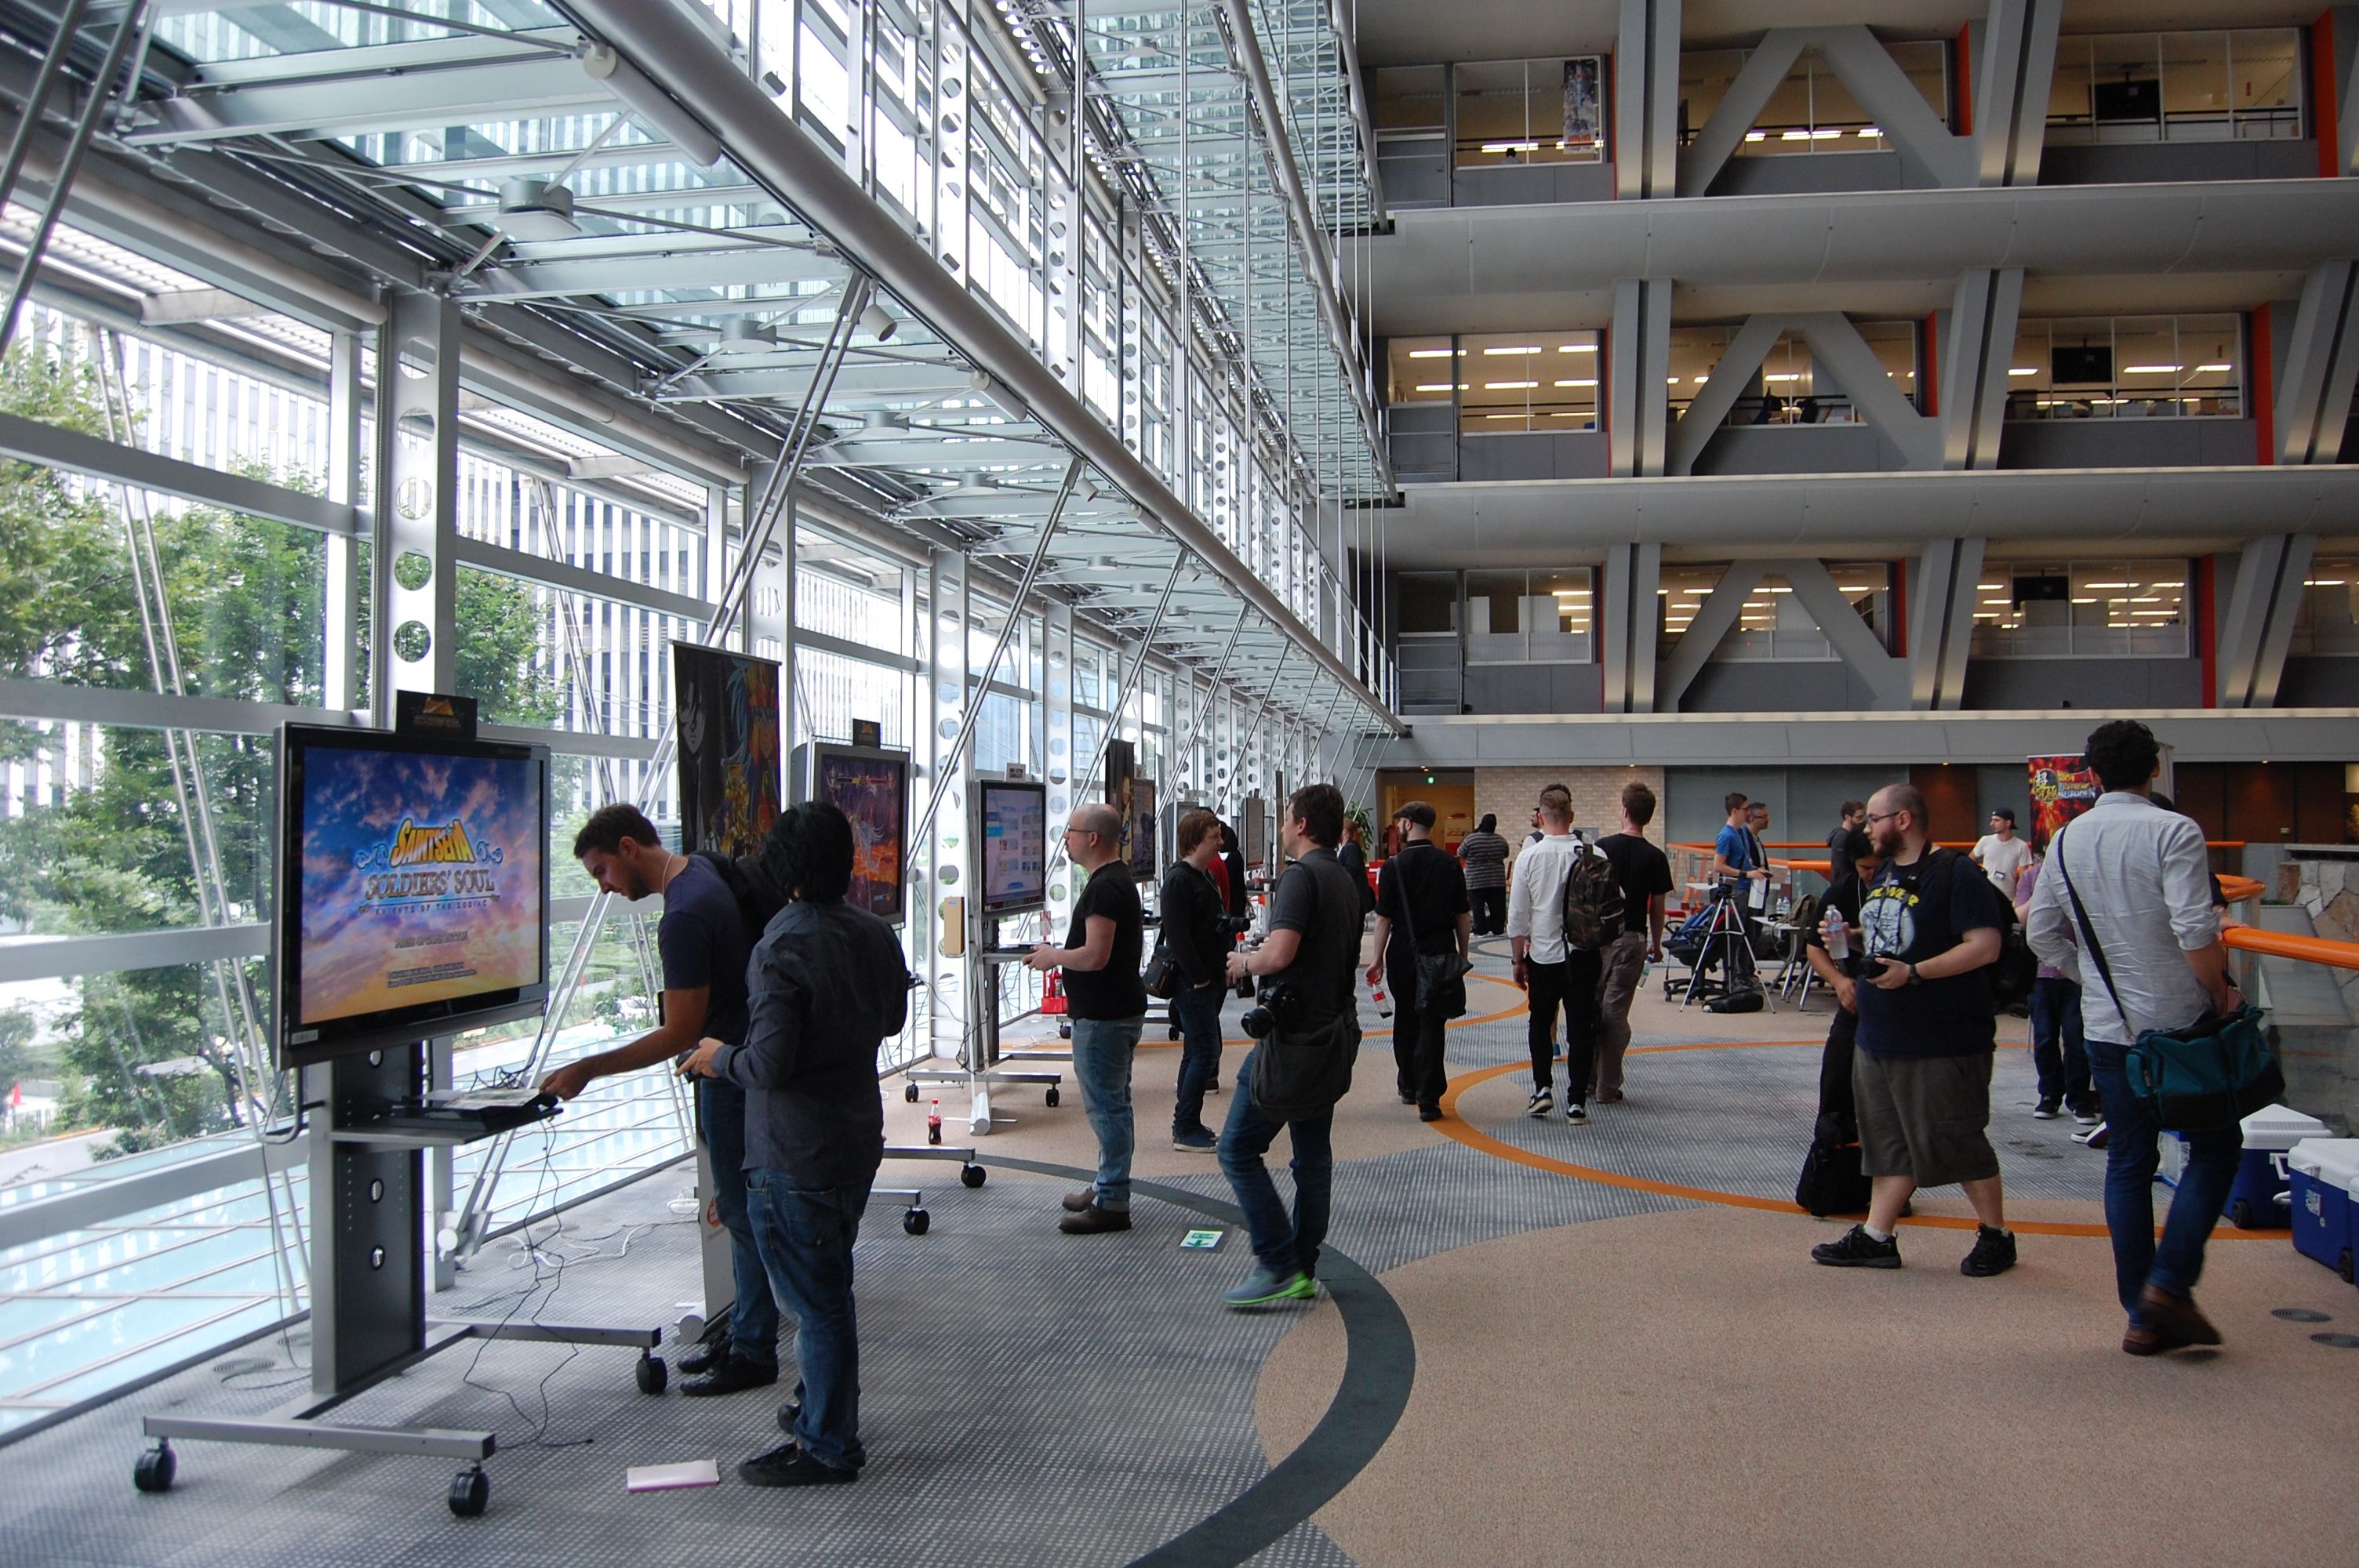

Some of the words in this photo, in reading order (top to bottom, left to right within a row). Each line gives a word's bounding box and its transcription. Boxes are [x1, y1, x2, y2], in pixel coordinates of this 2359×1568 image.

[454, 869, 495, 894] SOUL
[436, 902, 452, 910] THE
[457, 899, 487, 909] ZODIAC
